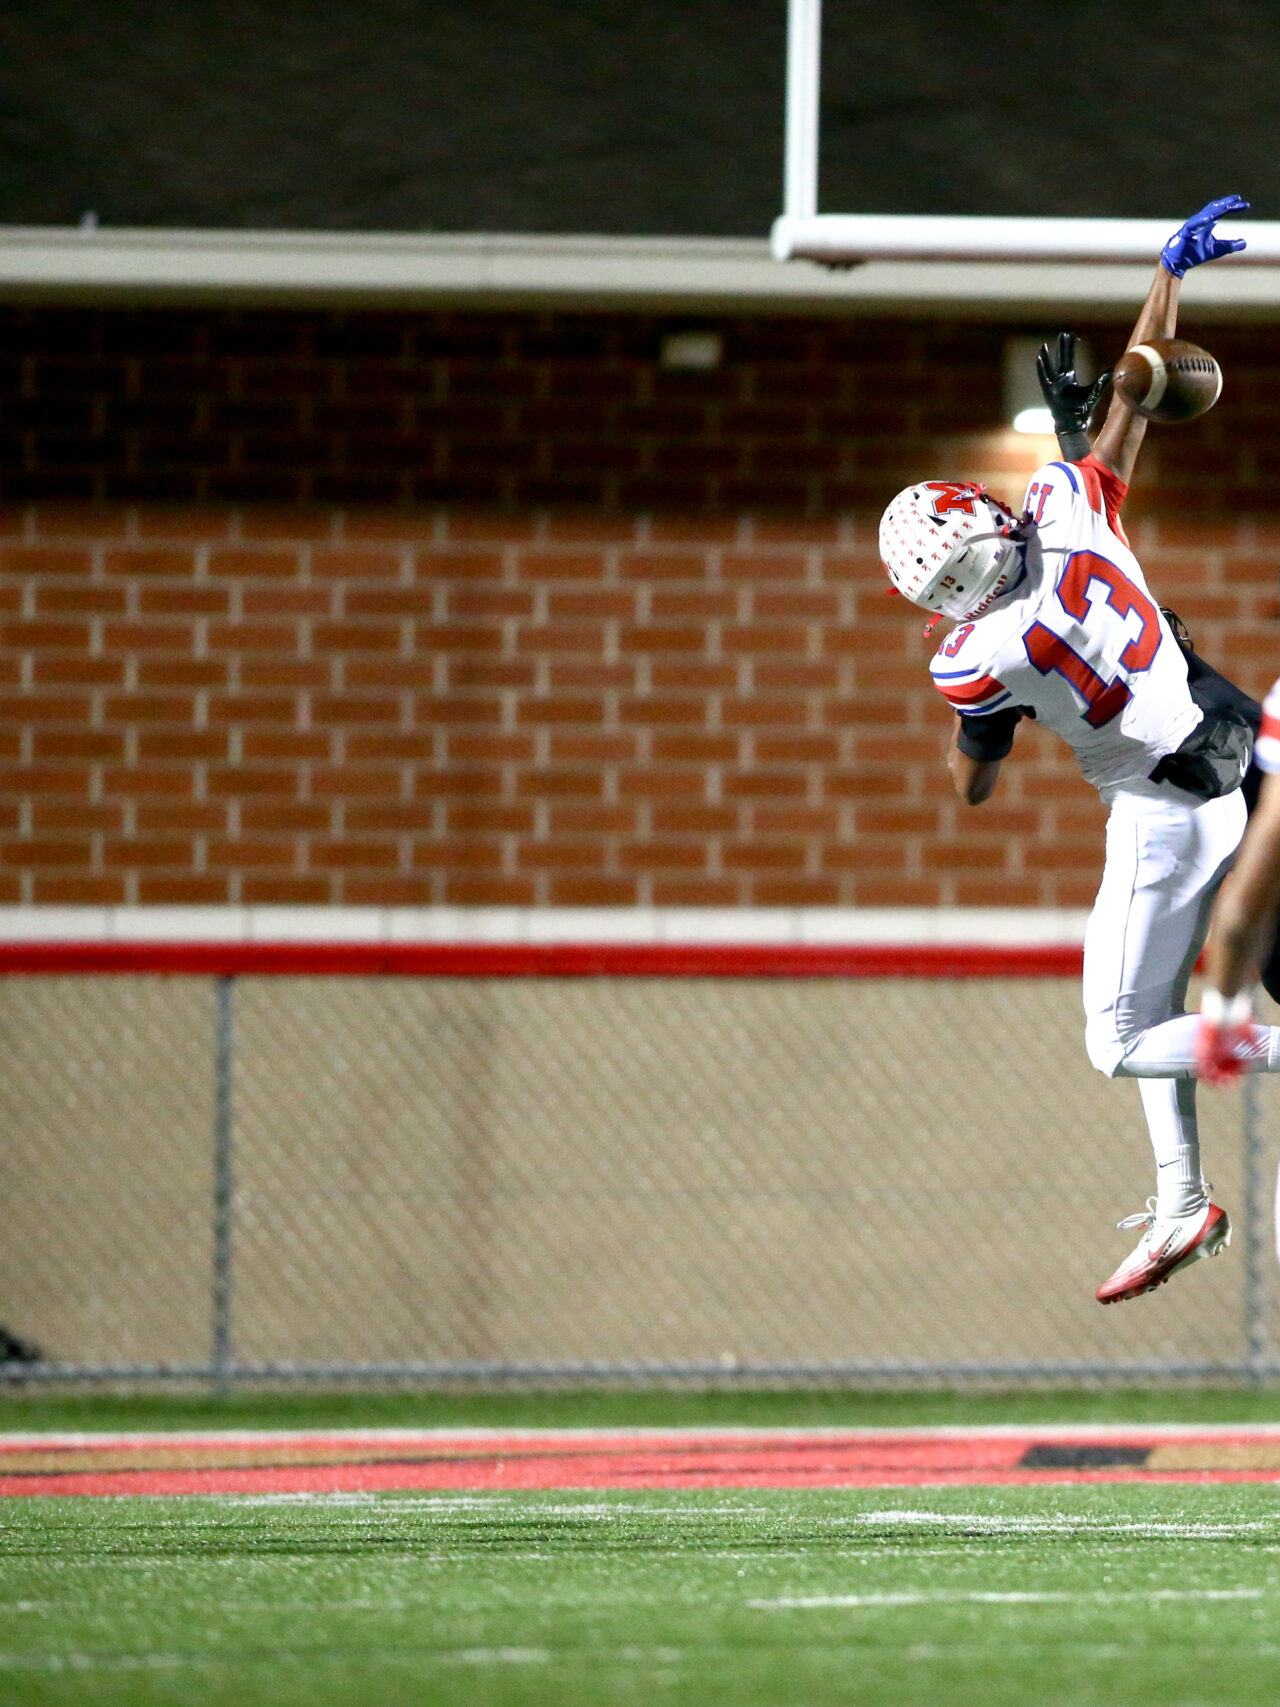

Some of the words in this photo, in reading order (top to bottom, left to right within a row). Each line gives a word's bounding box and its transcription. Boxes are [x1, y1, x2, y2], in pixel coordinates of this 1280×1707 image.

[940, 575, 956, 590] 13
[963, 574, 1008, 621] Riddell
[1022, 549, 1163, 729] 13
